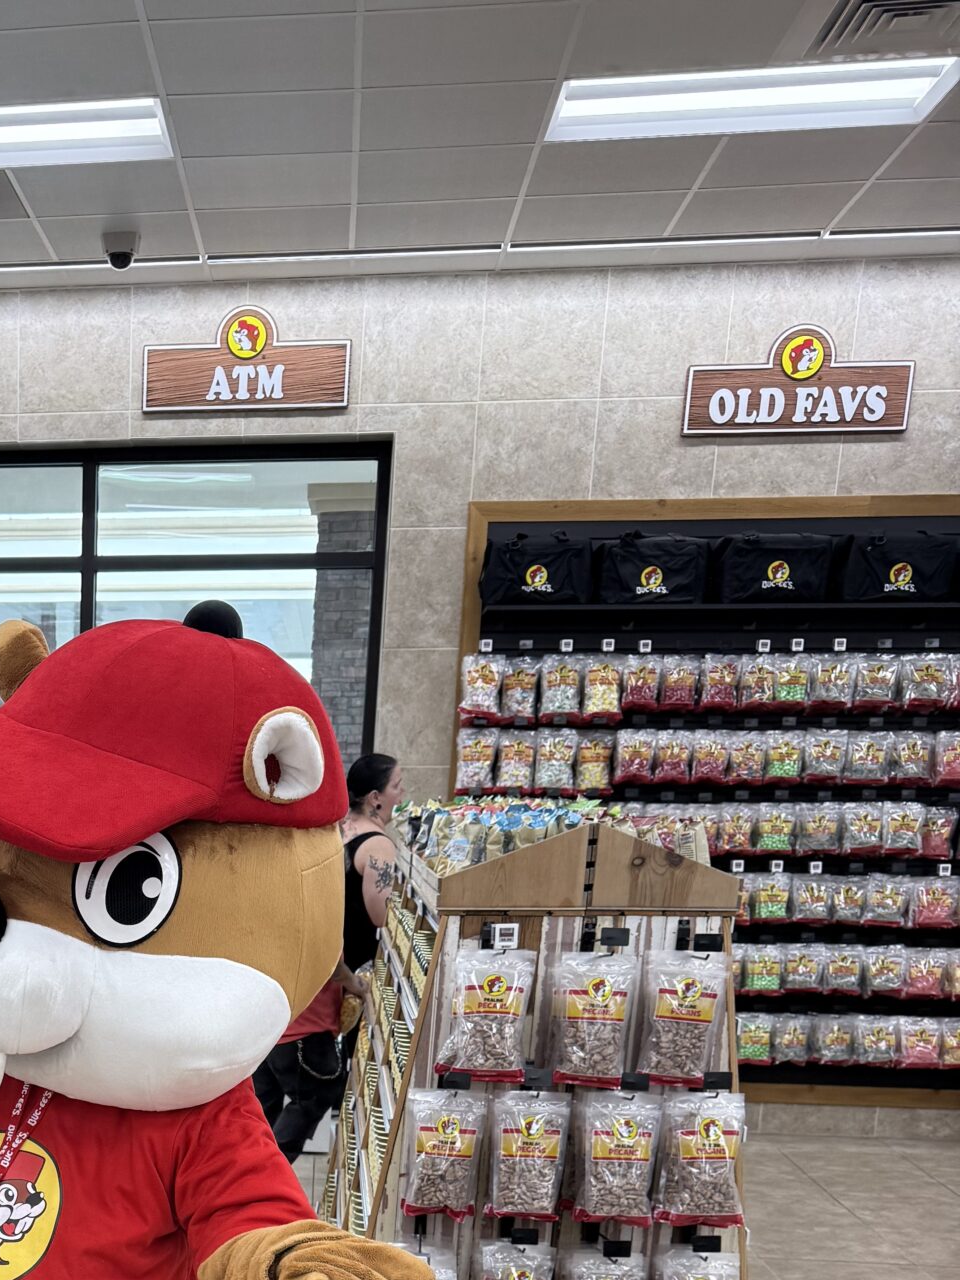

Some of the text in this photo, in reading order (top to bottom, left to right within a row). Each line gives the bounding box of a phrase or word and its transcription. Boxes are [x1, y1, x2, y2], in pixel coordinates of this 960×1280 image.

[205, 364, 285, 400] ATM
[709, 385, 888, 424] OLD FAVS
[12, 1083, 29, 1117] UC-EE'S
[27, 1090, 53, 1127] BUC-EE'S
[0, 1132, 29, 1168] BUC-EE'S
